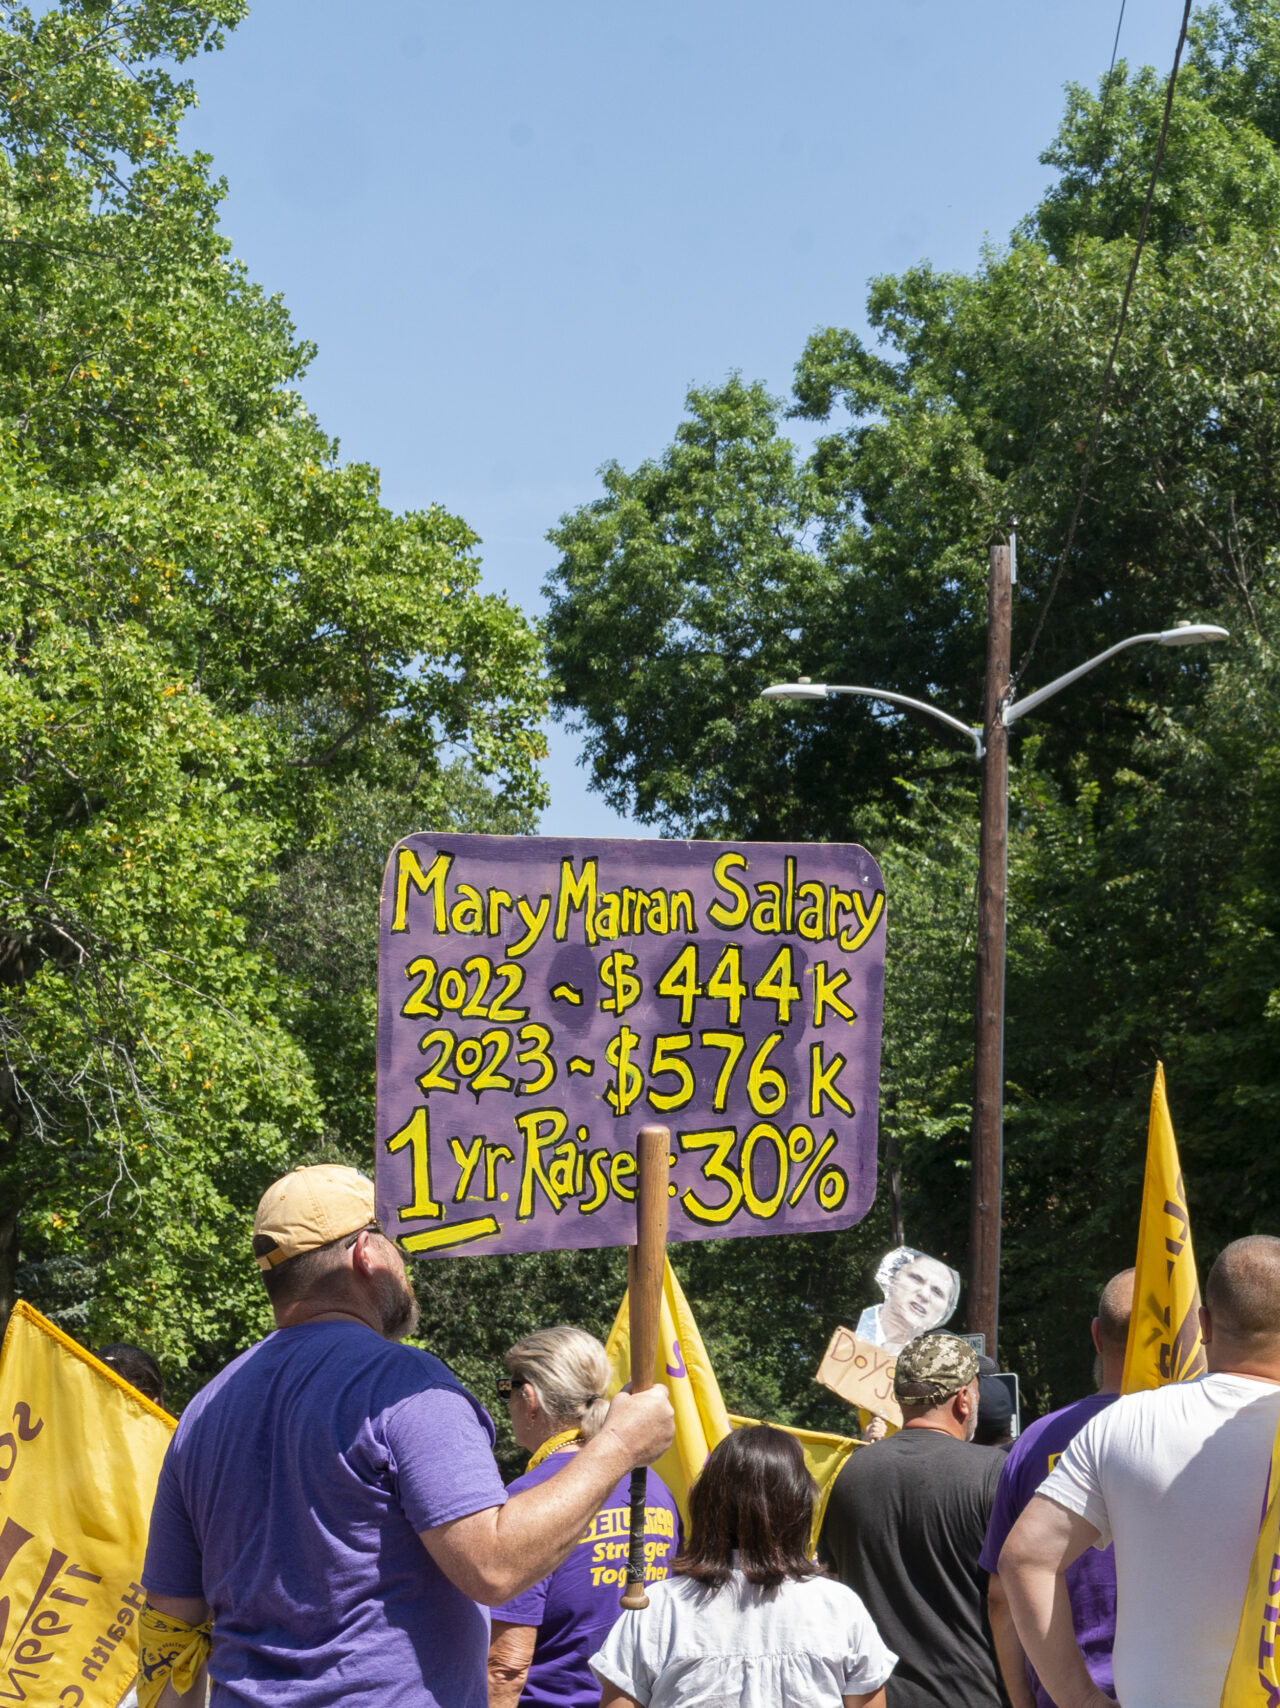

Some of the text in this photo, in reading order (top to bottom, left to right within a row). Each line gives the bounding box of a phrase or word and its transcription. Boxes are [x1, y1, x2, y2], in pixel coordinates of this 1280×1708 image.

[392, 846, 885, 958] Mary Marran Salary
[401, 955, 530, 1023] 2022
[417, 1023, 558, 1102] 2023
[385, 1106, 446, 1220] 1
